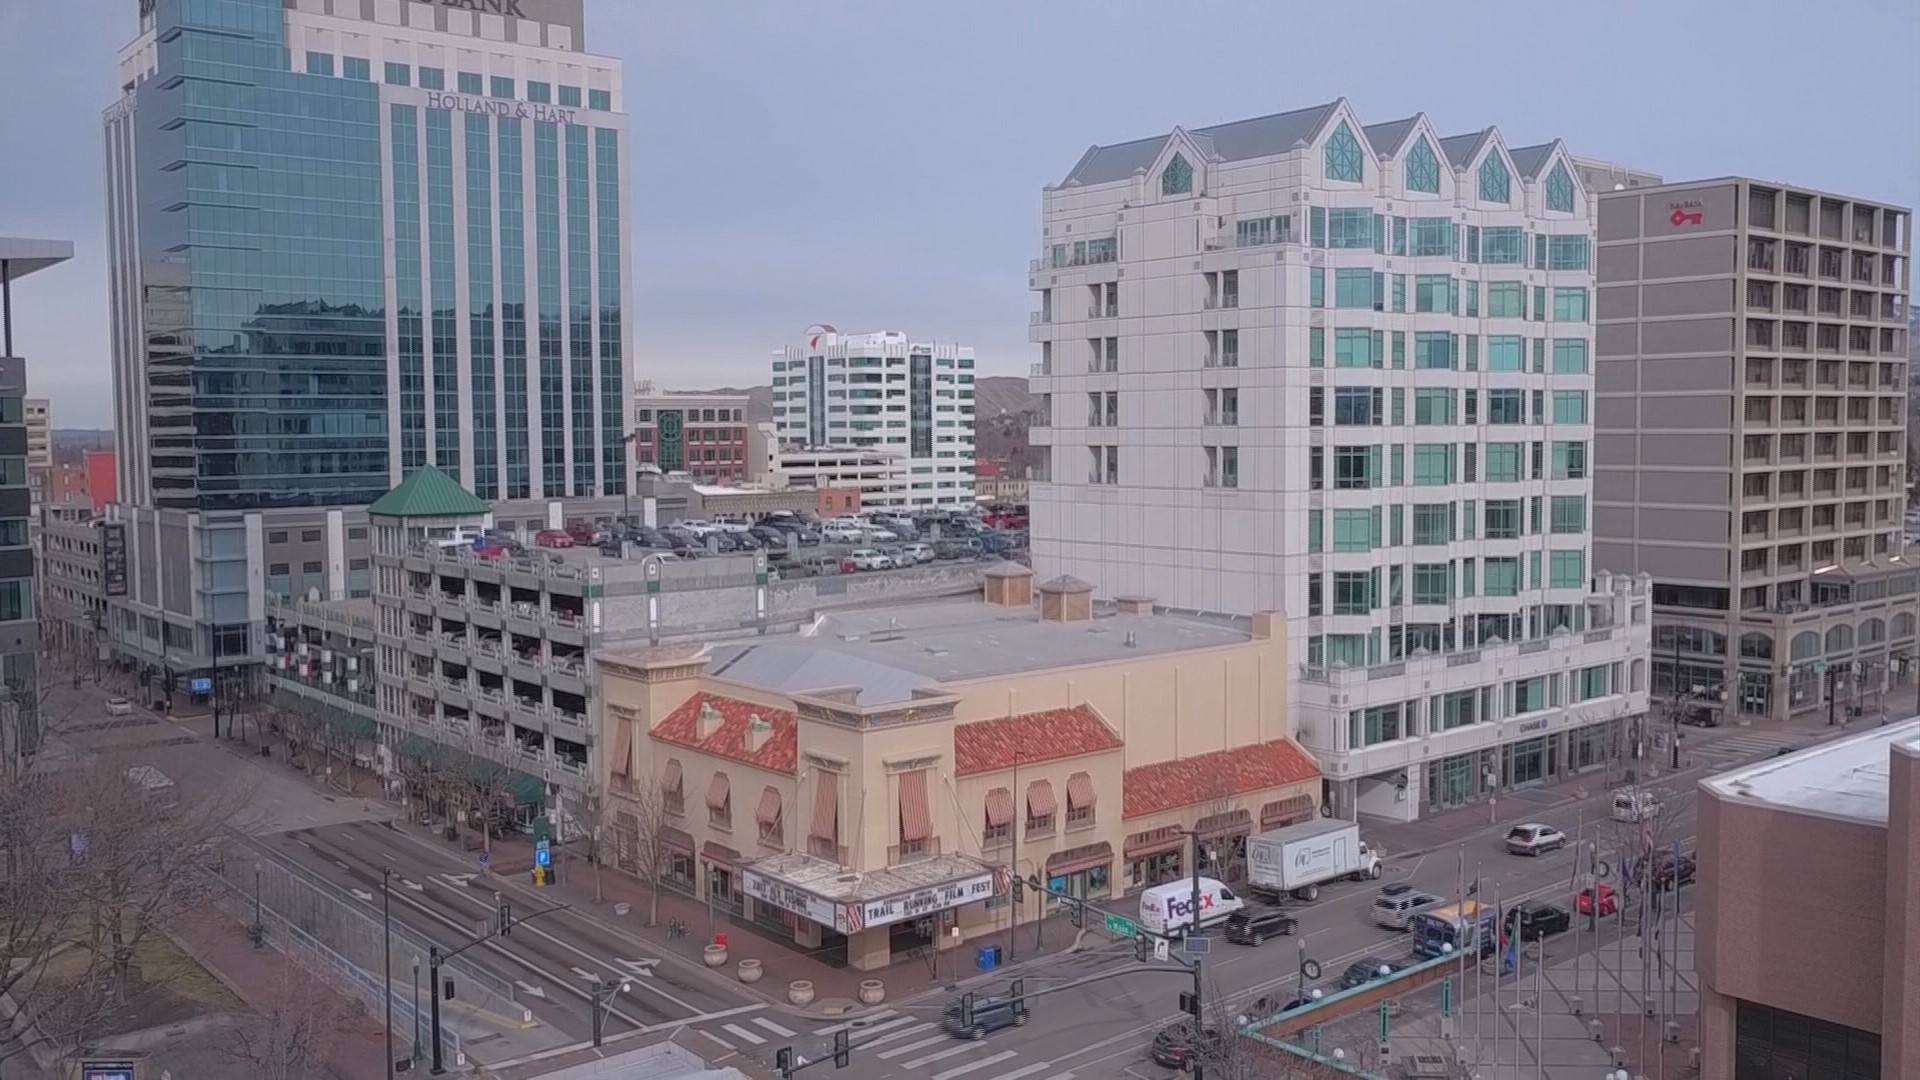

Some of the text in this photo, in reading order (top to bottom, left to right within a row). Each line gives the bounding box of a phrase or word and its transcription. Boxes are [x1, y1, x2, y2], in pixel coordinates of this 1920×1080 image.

[441, 0, 526, 18] ANK
[427, 91, 576, 124] HOLLAND & HART
[868, 904, 895, 921] TRAIL
[903, 893, 939, 913] RUNNING
[944, 887, 965, 902] FILM
[971, 880, 992, 895] FEST
